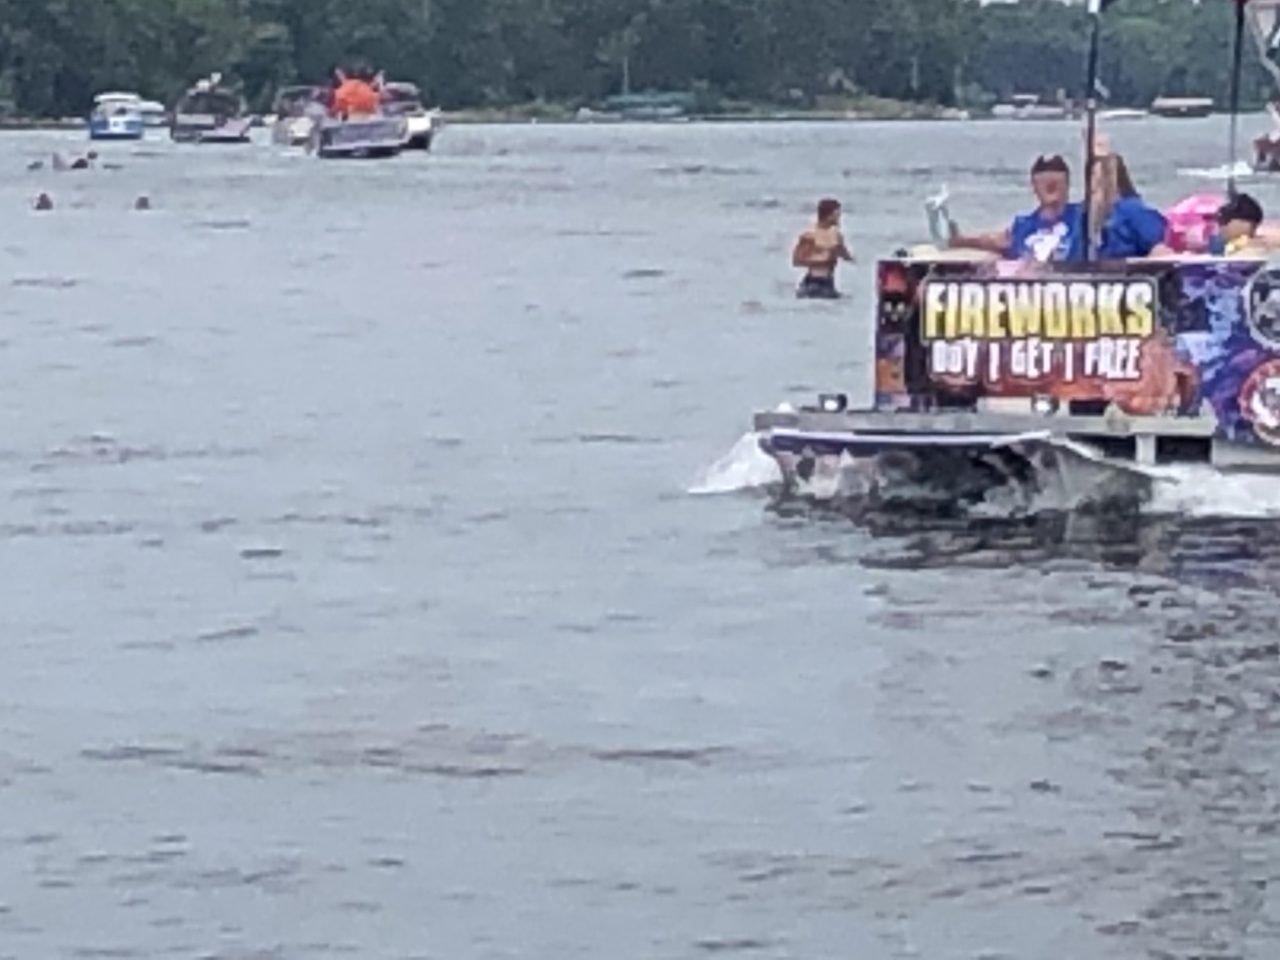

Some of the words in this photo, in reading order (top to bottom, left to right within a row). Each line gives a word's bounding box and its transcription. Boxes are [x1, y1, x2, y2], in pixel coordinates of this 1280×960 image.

[925, 282, 1152, 337] FIREWORKS
[1011, 339, 1053, 378] GET
[1085, 339, 1141, 380] FREE
